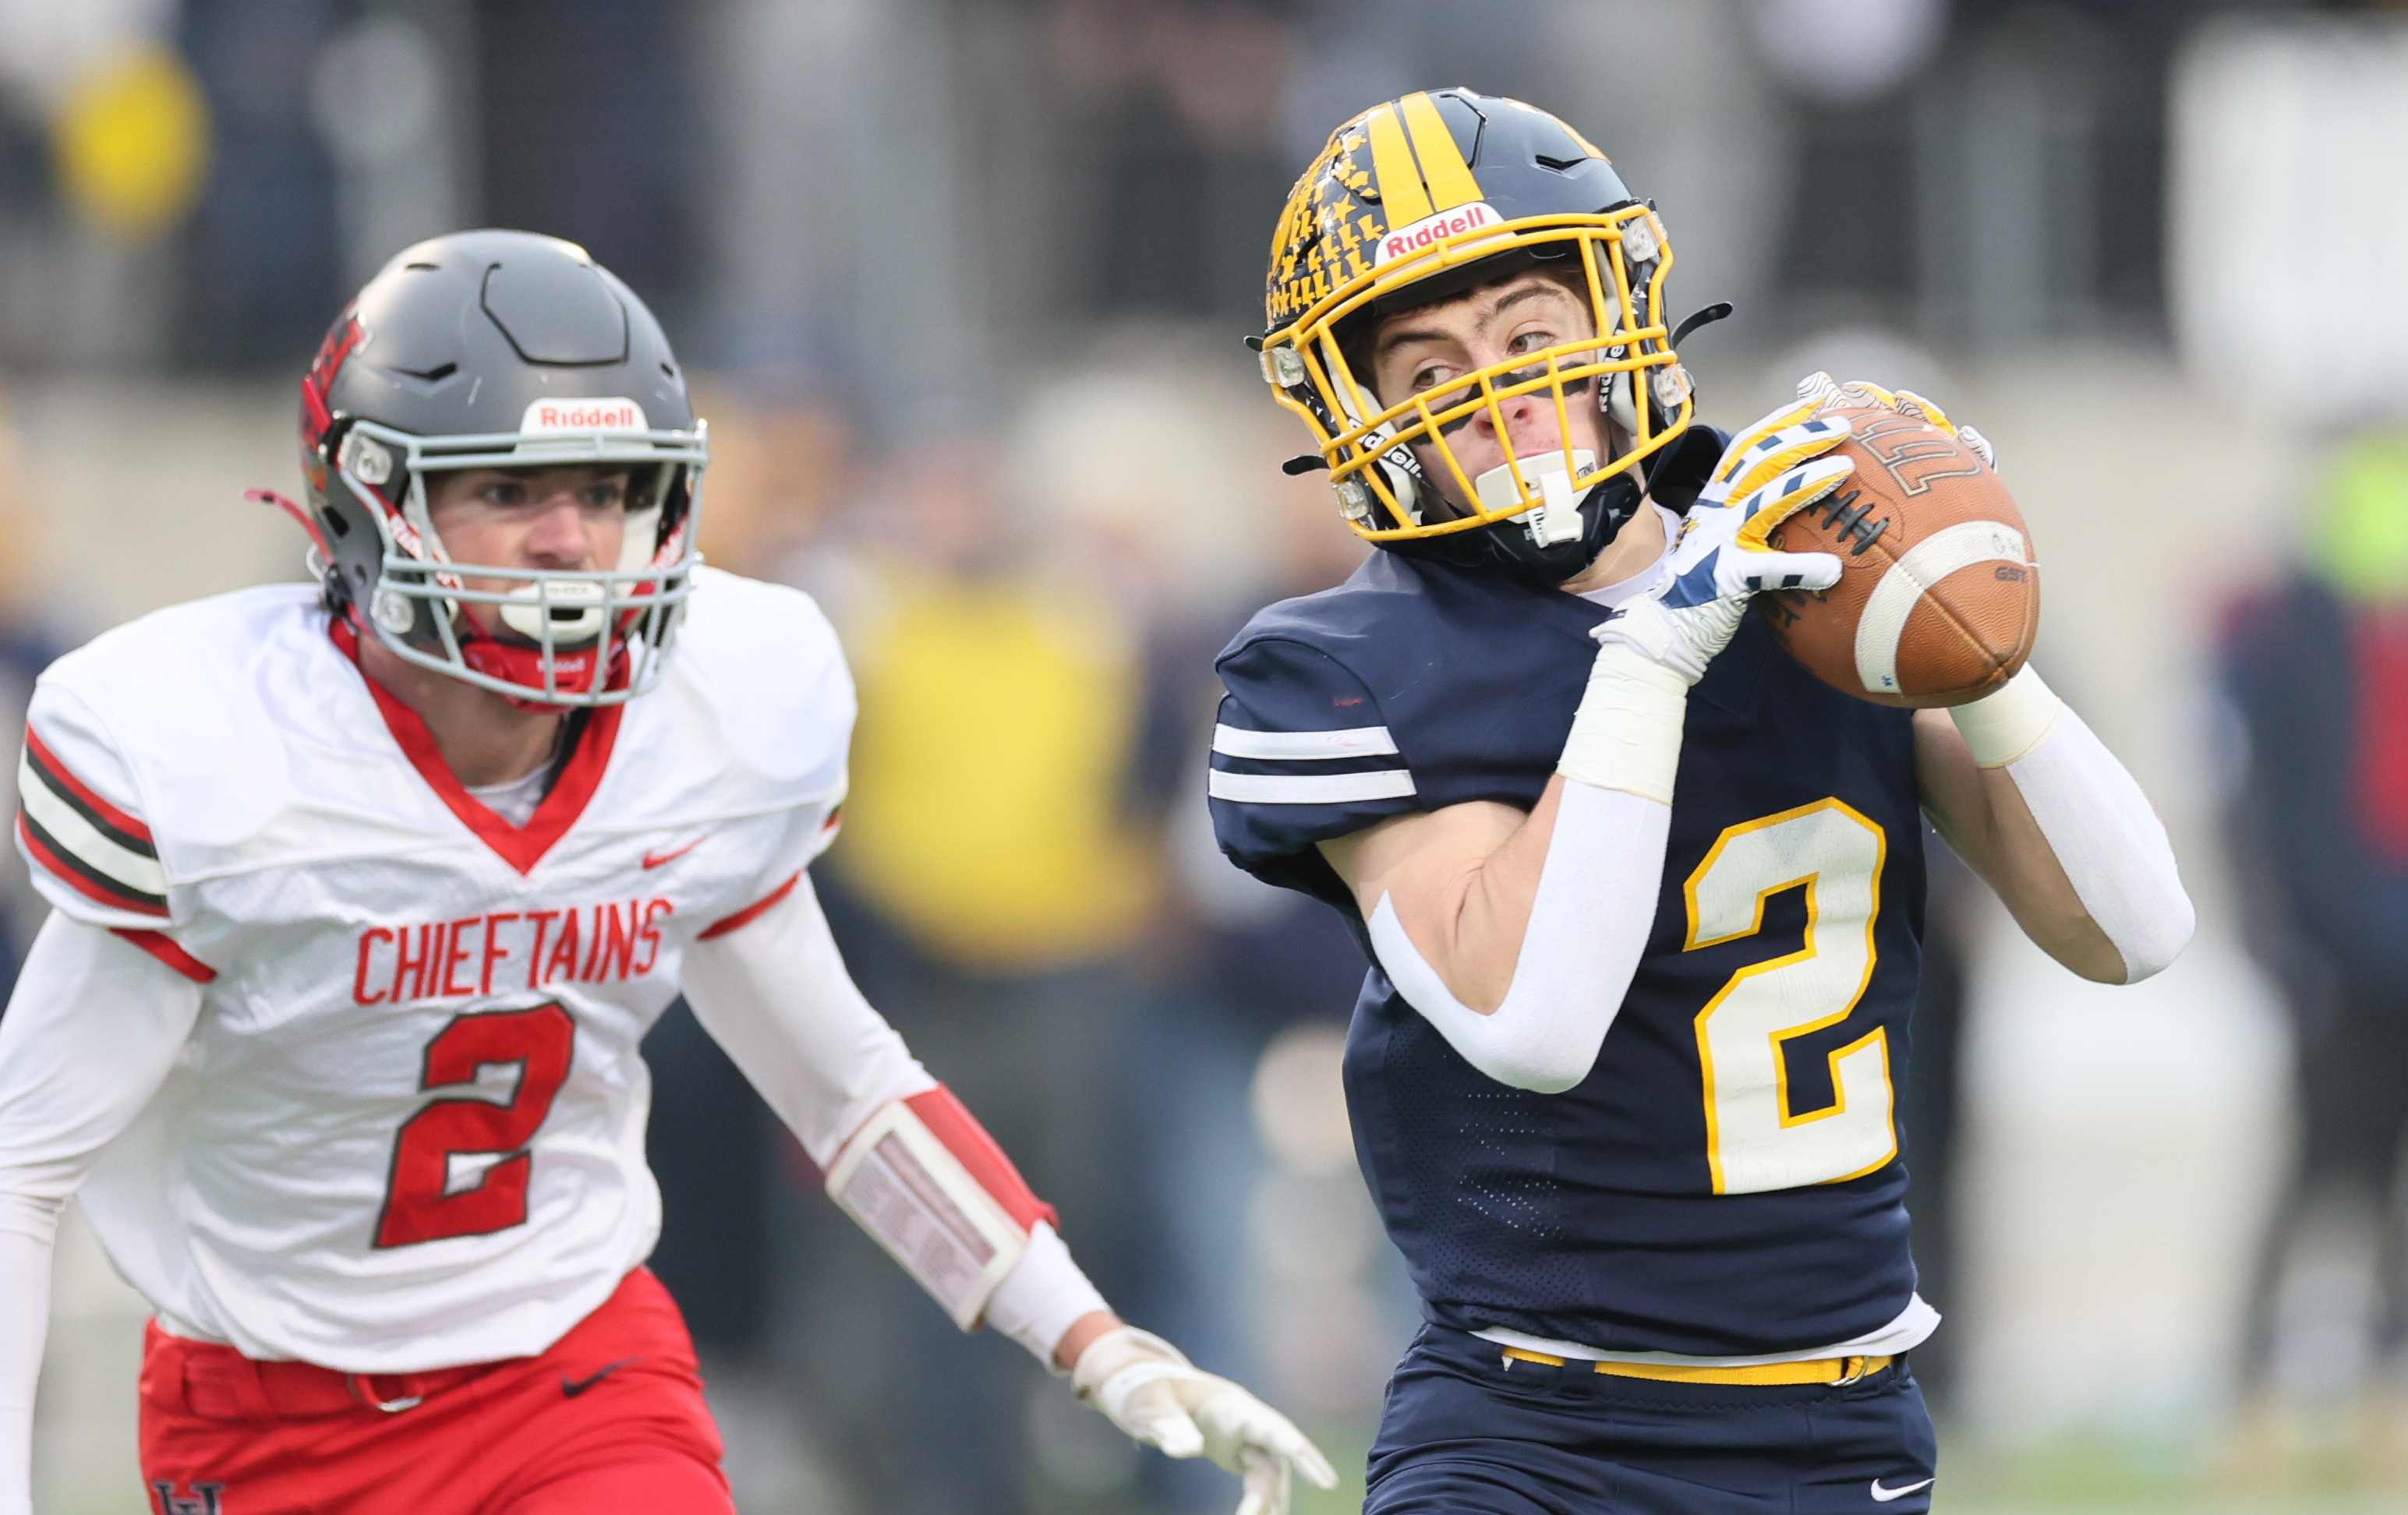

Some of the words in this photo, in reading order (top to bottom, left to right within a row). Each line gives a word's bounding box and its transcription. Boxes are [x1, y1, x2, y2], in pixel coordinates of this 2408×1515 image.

[1387, 207, 1485, 258] Riddell
[541, 408, 633, 426] Riddell
[353, 899, 674, 1006] CHIEFTAINS
[1682, 796, 1898, 1195] 2
[370, 1000, 575, 1250] 2
